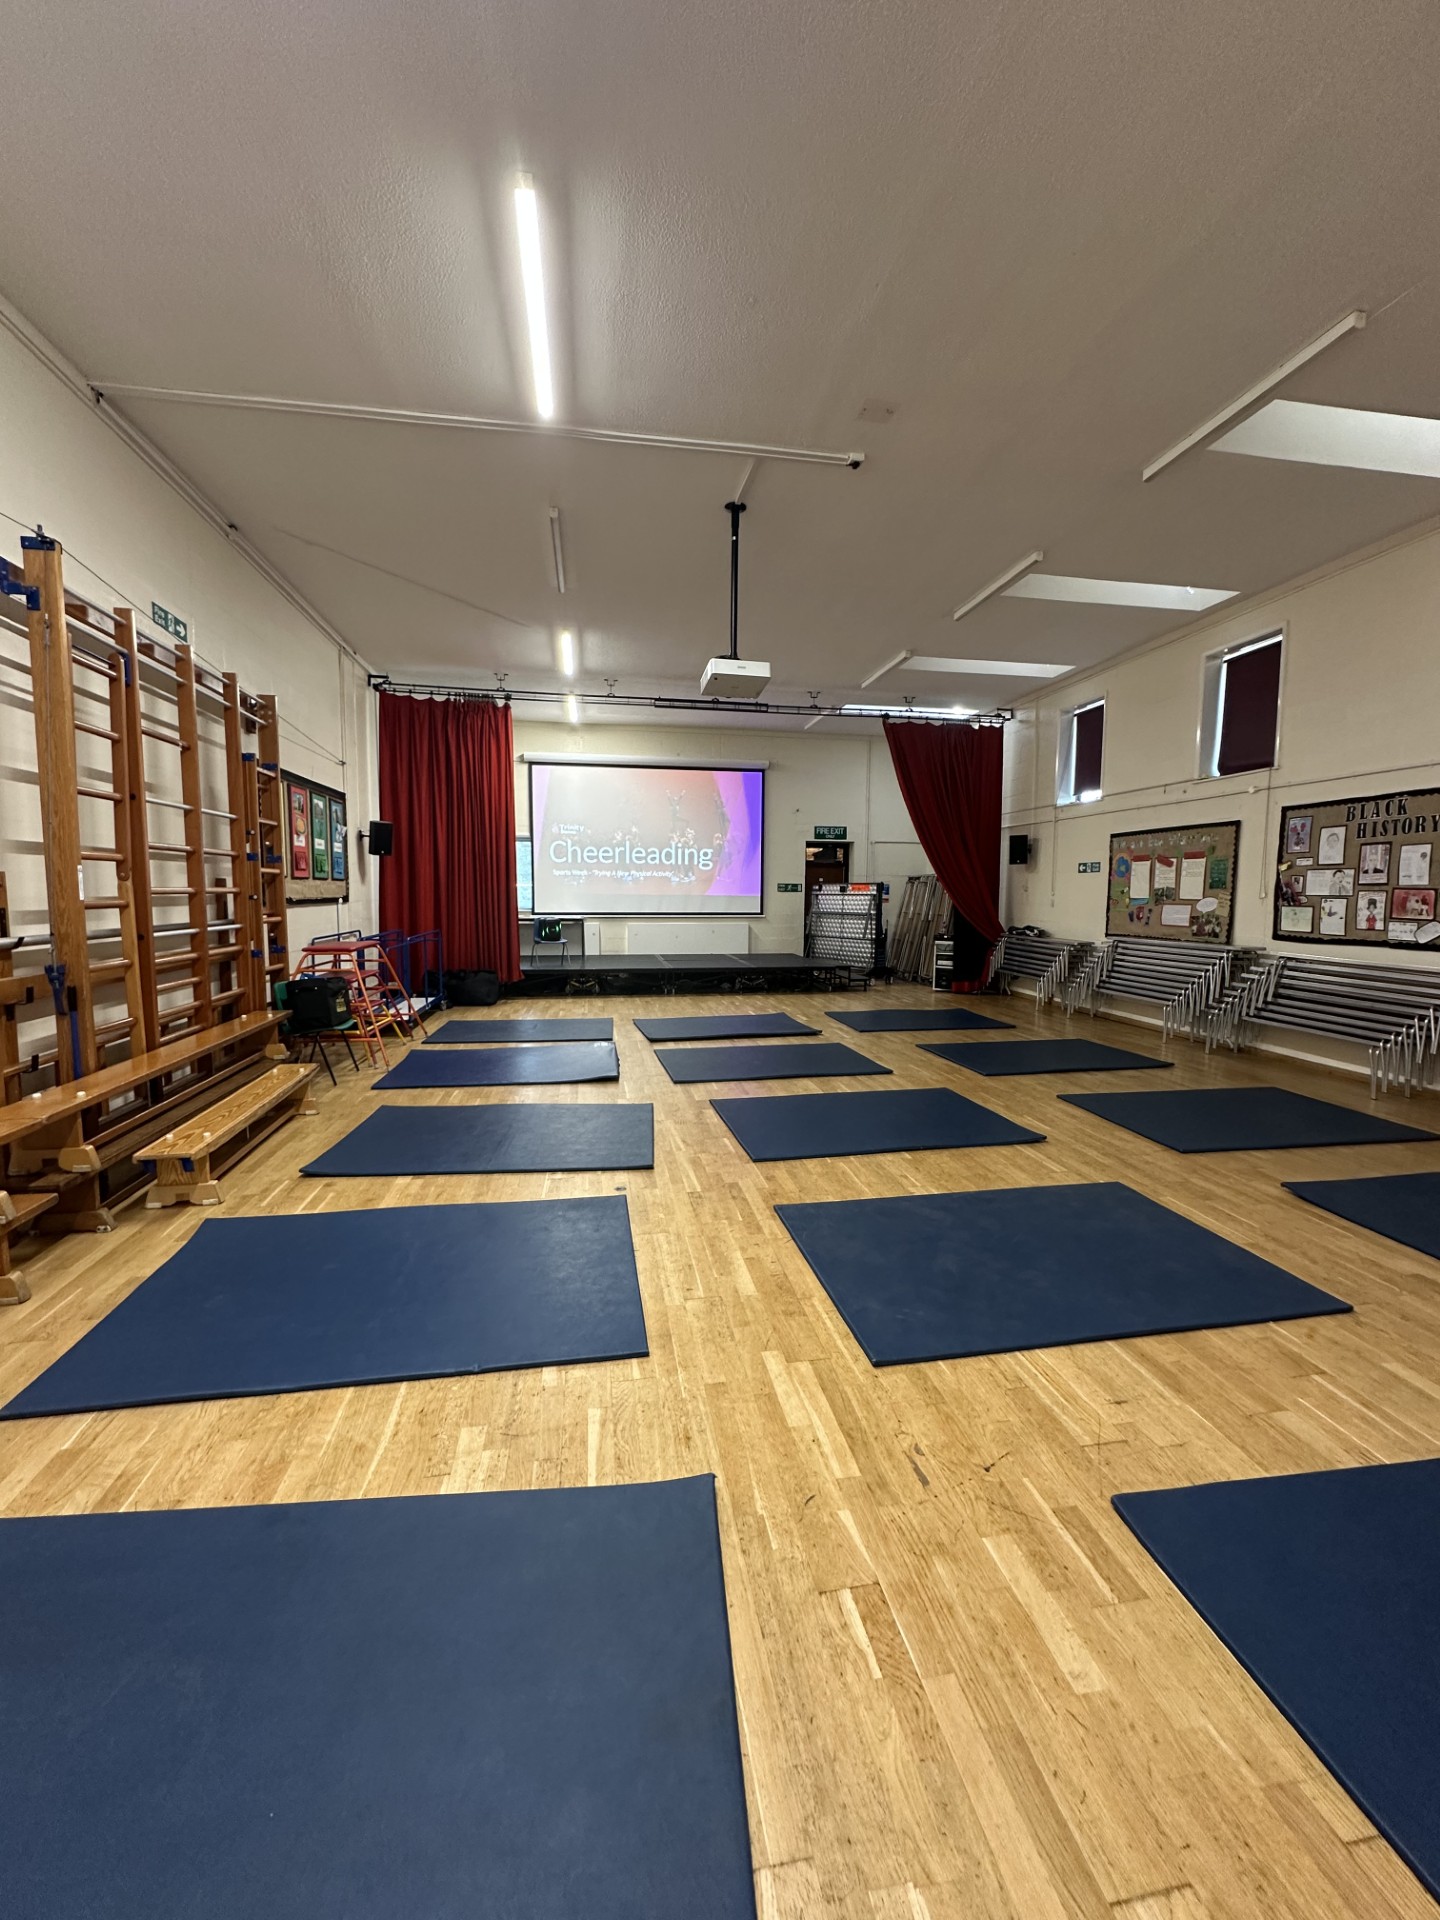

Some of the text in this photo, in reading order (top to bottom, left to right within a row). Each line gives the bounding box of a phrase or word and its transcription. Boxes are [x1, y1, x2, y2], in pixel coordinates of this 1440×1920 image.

[1346, 798, 1408, 822] BLACK
[1356, 814, 1440, 839] HISTORY
[549, 839, 714, 870] Cheerleading
